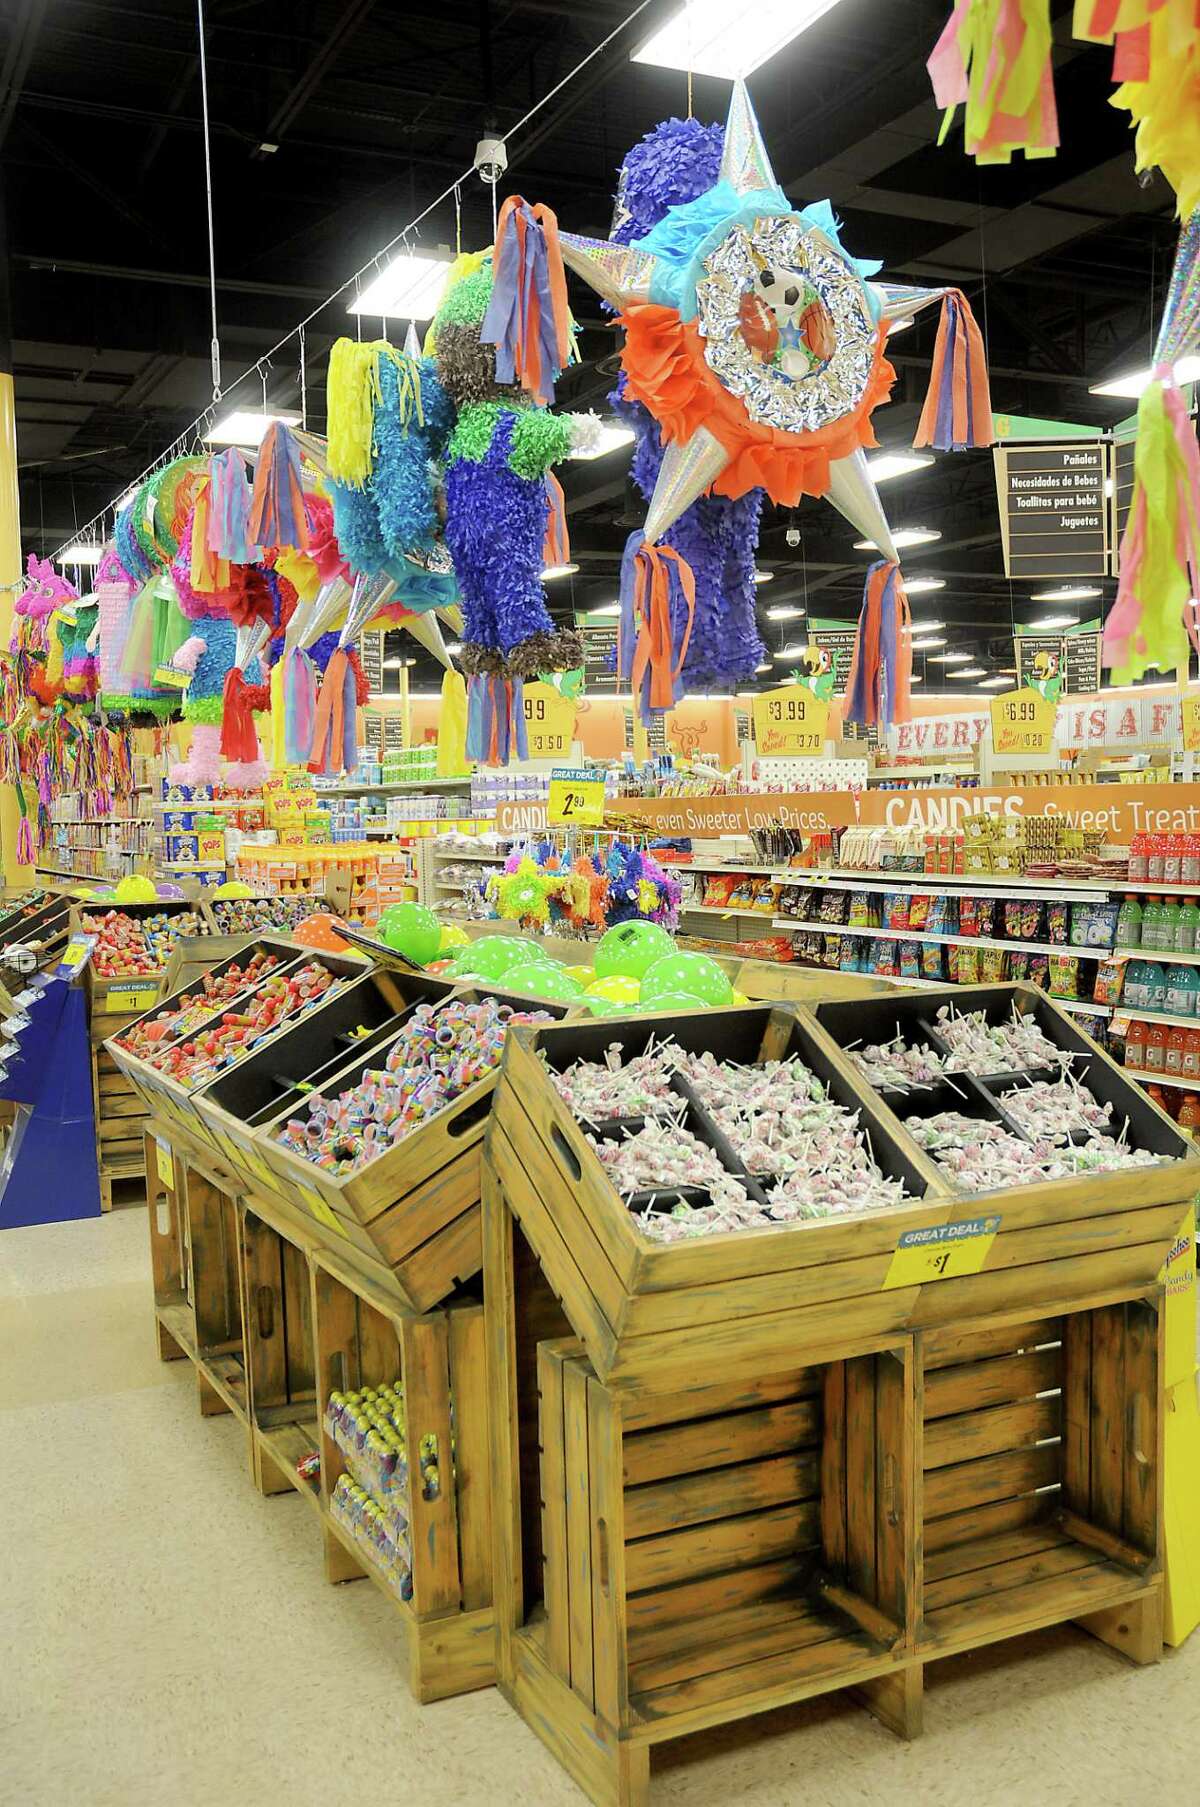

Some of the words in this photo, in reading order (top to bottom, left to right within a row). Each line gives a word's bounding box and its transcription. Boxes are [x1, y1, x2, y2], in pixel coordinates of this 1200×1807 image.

[1063, 453, 1098, 465] Pañales
[1011, 476, 1060, 489] Necesidades
[1062, 476, 1072, 487] de
[1074, 475, 1098, 486] Bebes
[1016, 496, 1052, 508] Toallitas
[1054, 497, 1075, 509] para
[1060, 516, 1099, 529] Juguetes
[769, 701, 805, 721] $3.99
[1005, 702, 1035, 721] $6.99
[1073, 710, 1107, 741] IS
[1116, 704, 1140, 738] A
[898, 718, 990, 749] EVERY
[552, 770, 575, 778] GREAT
[576, 771, 595, 780] DEAL
[502, 806, 546, 830] CANDI
[656, 815, 684, 830] even
[686, 808, 742, 830] Sweeter
[744, 806, 777, 830] Low
[780, 805, 831, 830] Prices.
[885, 796, 1024, 833] CANDIES
[1043, 802, 1121, 833] Sweet
[904, 1228, 948, 1244] GREAT
[948, 1223, 979, 1237] DEAL
[933, 1253, 951, 1274] $1
